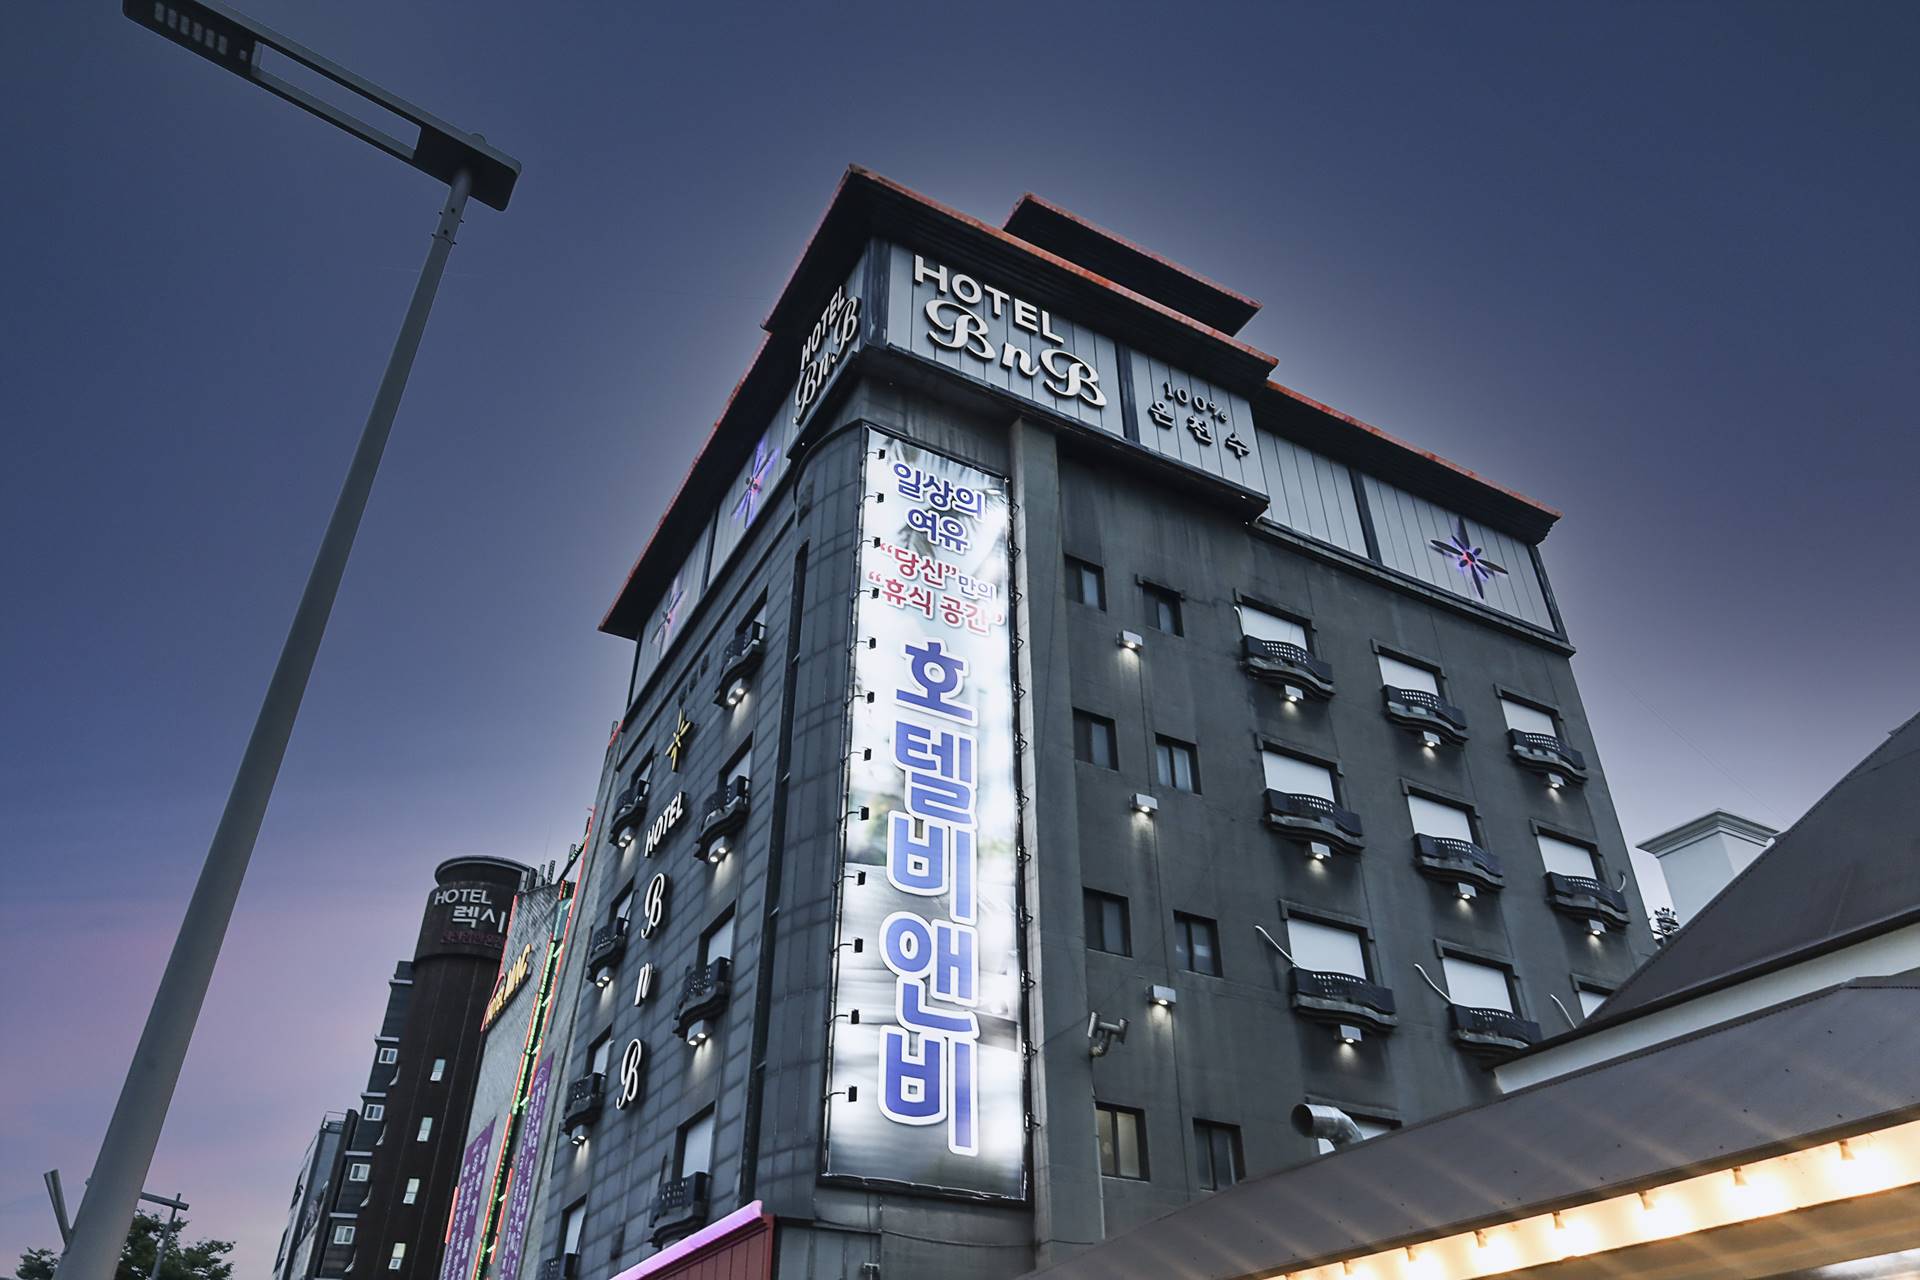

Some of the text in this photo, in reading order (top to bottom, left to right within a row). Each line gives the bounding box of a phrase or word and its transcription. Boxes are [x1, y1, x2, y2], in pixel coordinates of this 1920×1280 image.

[914, 254, 1064, 344] HOTEL
[800, 285, 845, 370] HOTEL
[925, 299, 1107, 407] BnB
[1163, 382, 1228, 424] 100%
[892, 462, 983, 517] 일상의
[906, 508, 969, 552] 여유
[644, 792, 684, 858] HOTEL
[434, 889, 492, 905] HOTEL
[452, 905, 506, 933] 렉시
